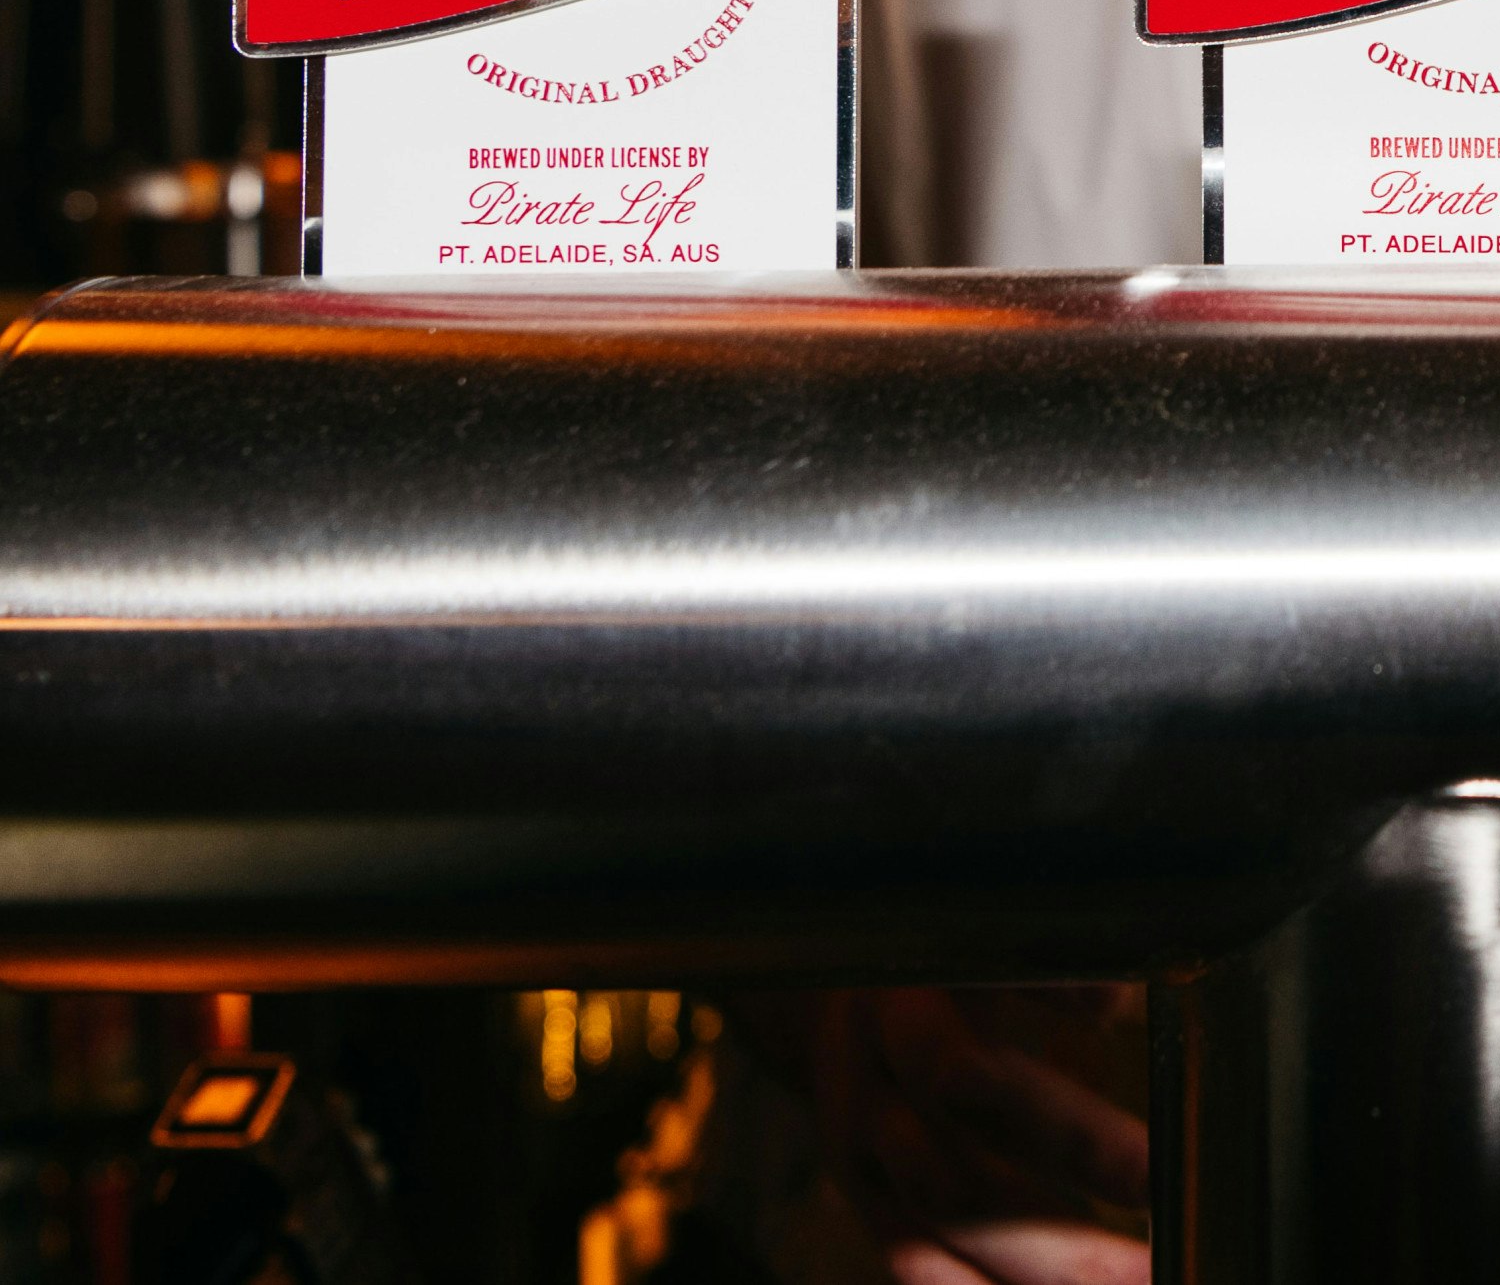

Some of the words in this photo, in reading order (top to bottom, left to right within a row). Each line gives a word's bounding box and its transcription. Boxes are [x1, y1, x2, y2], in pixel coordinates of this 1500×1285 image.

[466, 53, 619, 105] ORIGINAL
[469, 148, 541, 169] BREWED
[547, 148, 604, 168] UNDER
[611, 147, 681, 167] LICENSE
[688, 147, 709, 167] BY
[1370, 137, 1443, 158] BREWED
[1362, 170, 1498, 215] Pirate
[460, 180, 595, 225] Pirate
[599, 172, 705, 247] Life
[439, 245, 474, 264] PT.
[483, 245, 613, 265] ADELAIDE,
[623, 244, 661, 263] SA.
[671, 243, 720, 263] AUS
[1340, 235, 1376, 253] PT.
